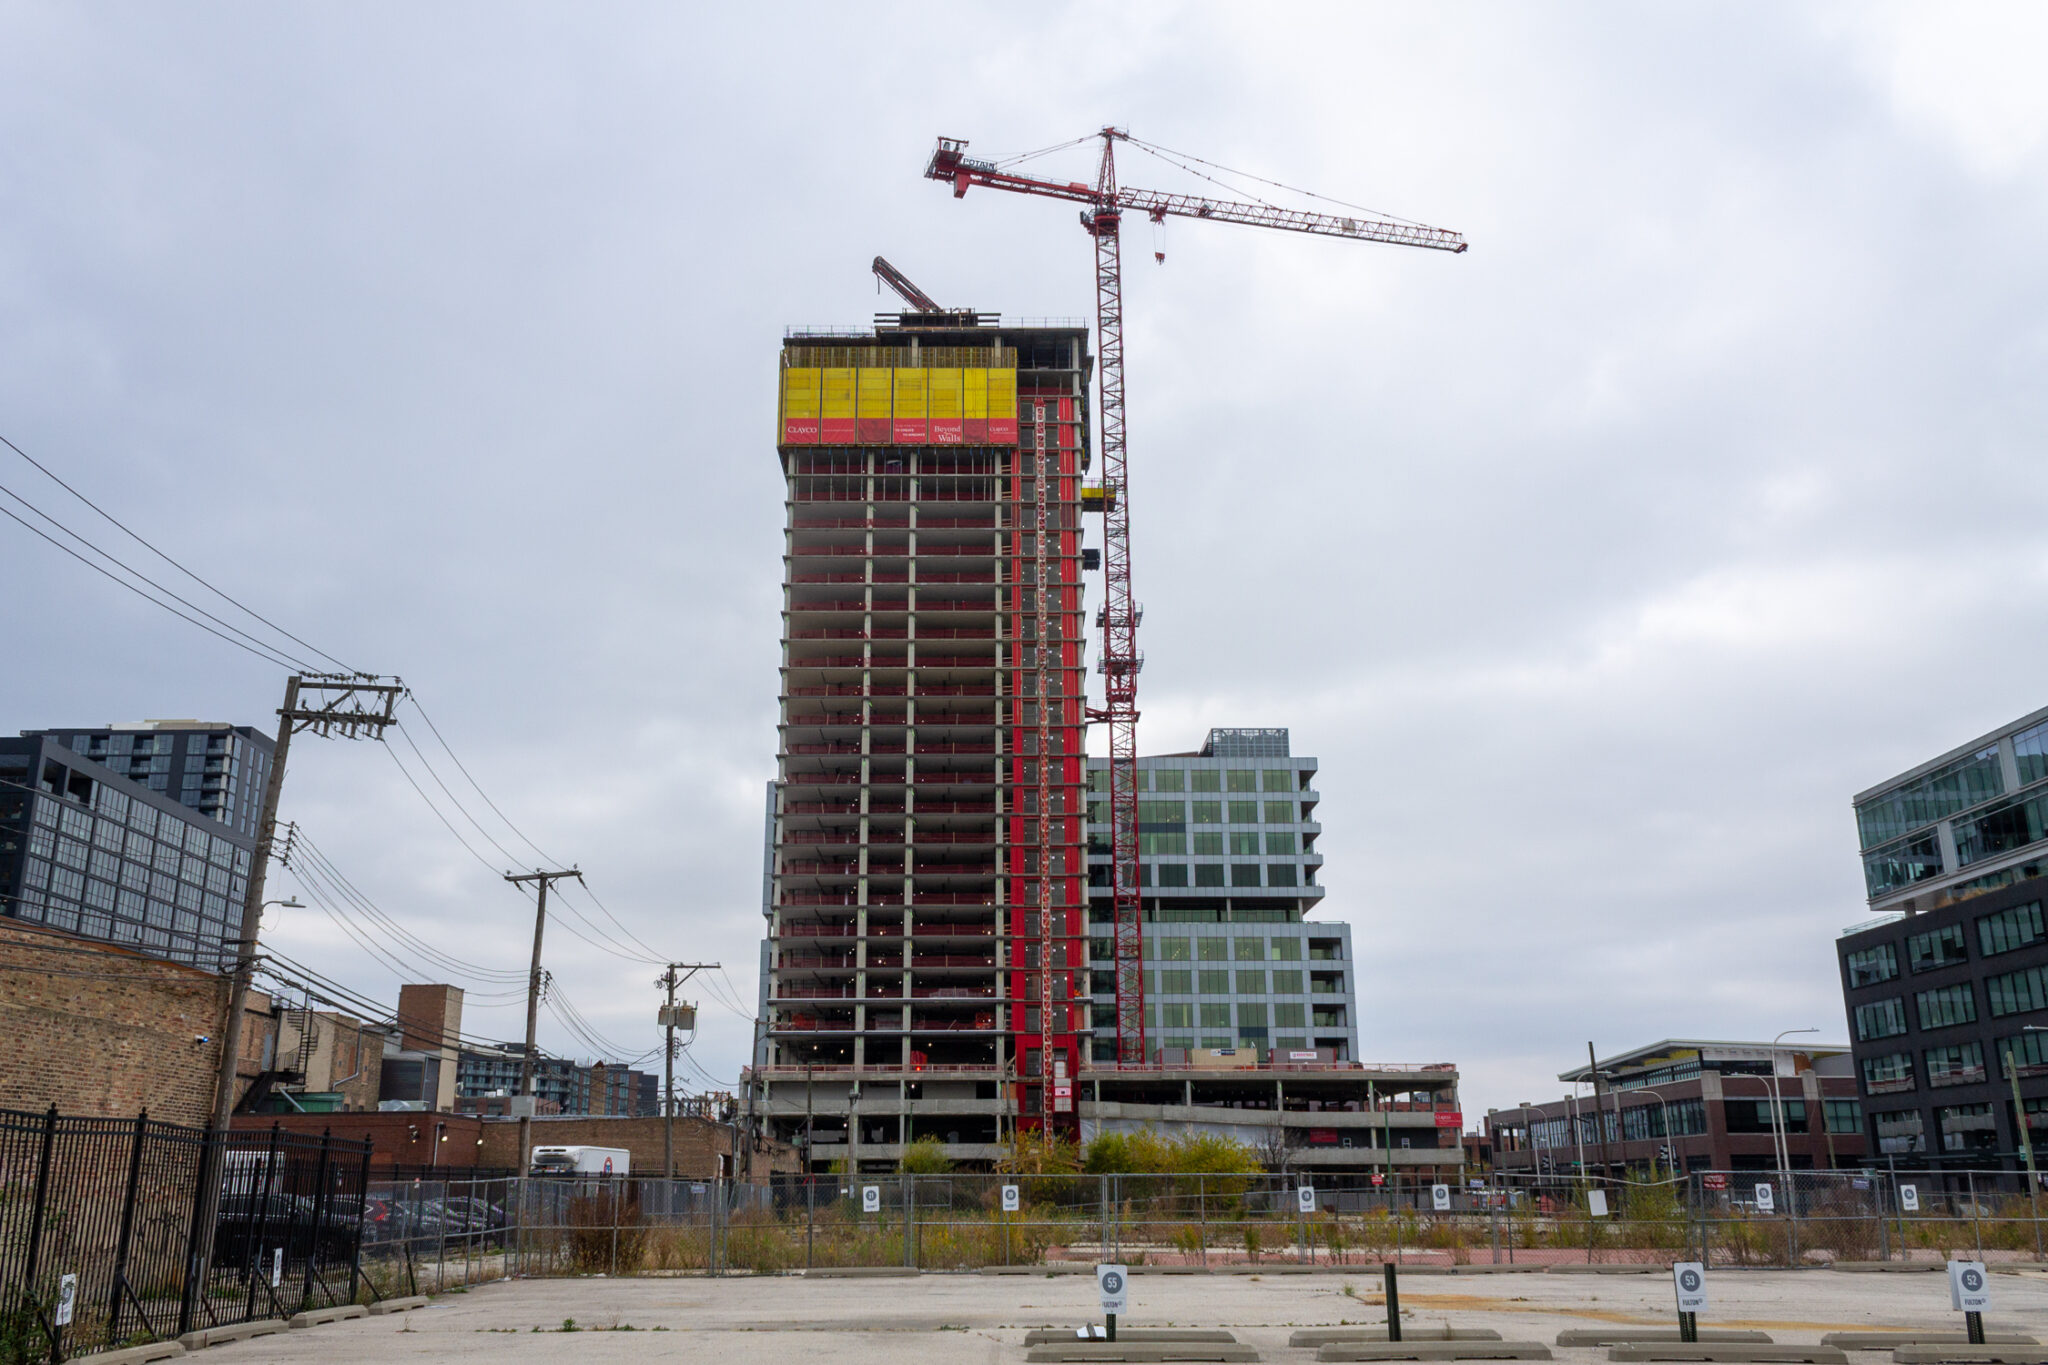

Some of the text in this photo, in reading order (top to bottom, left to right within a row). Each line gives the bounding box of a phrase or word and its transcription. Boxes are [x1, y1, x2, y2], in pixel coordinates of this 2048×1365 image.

[963, 157, 995, 169] POTAIN
[787, 426, 818, 434] CLAYCO
[934, 425, 961, 434] Beyond
[938, 434, 961, 442] Walls
[1107, 1276, 1118, 1288] 55
[1685, 1274, 1696, 1286] 53
[1966, 1274, 1978, 1286] 52
